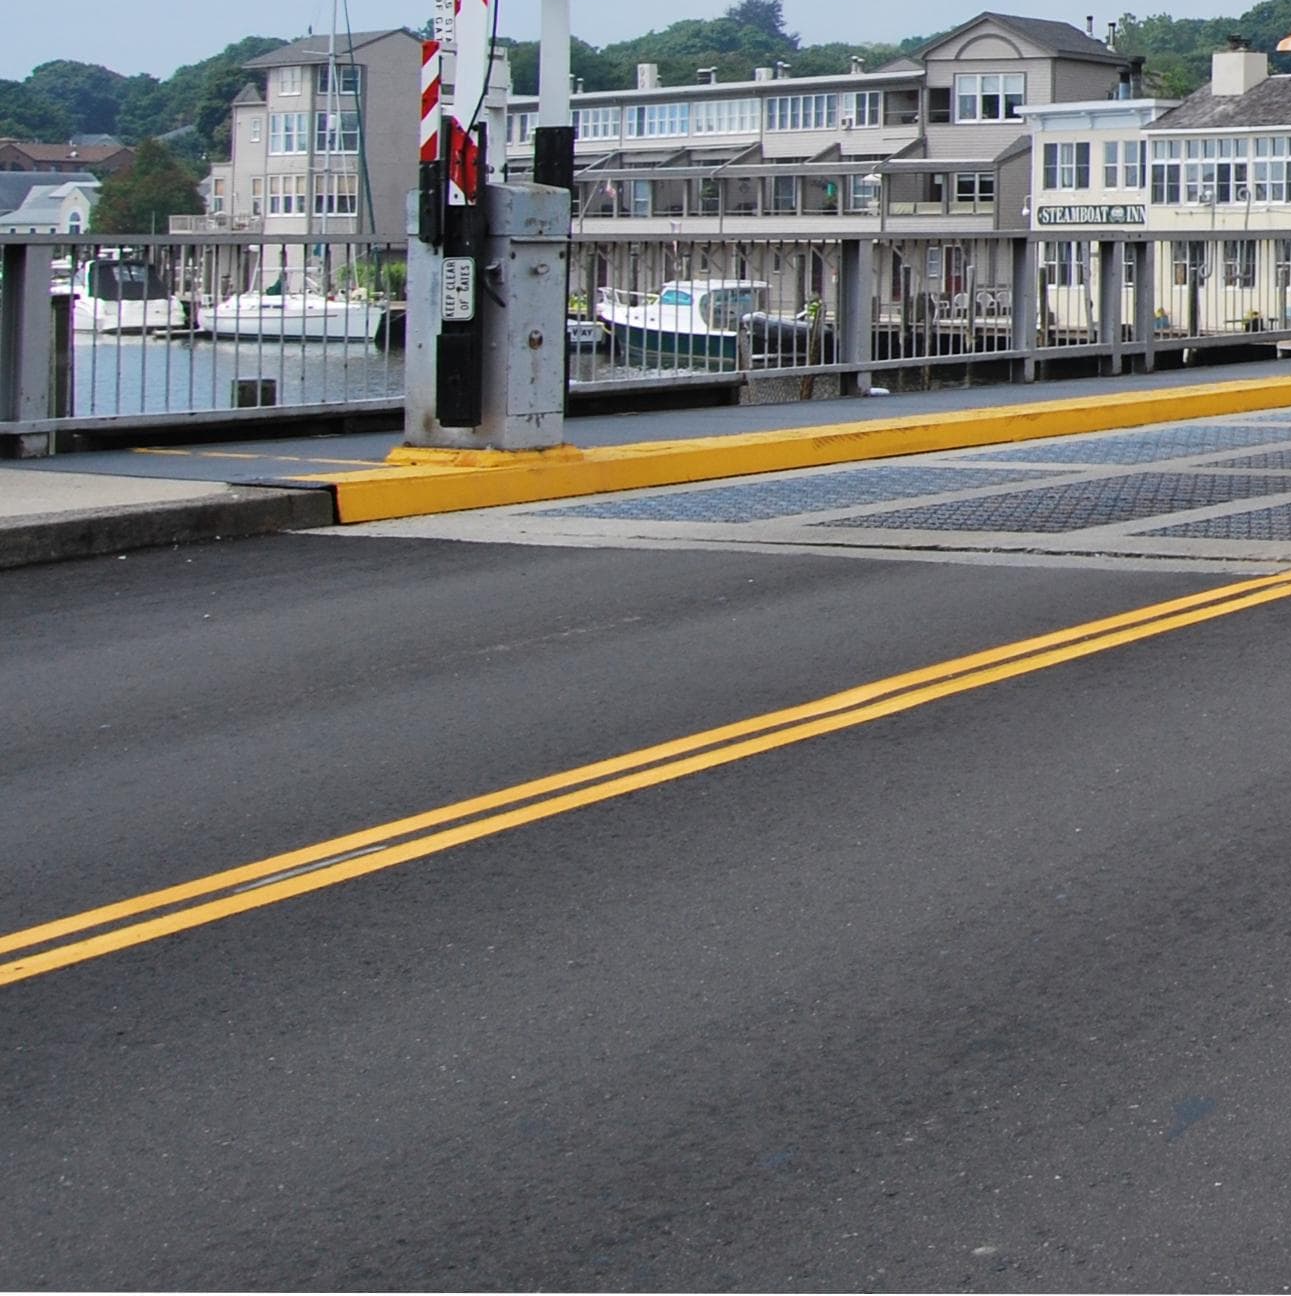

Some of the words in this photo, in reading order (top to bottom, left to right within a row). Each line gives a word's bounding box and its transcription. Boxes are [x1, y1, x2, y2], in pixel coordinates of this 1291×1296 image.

[445, 17, 453, 43] STA
[1042, 206, 1109, 224] STEAMBOAT
[1126, 206, 1146, 223] INN
[446, 261, 456, 291] CLEAR
[460, 265, 470, 292] GATES
[445, 294, 455, 318] KEEP
[459, 299, 470, 311] OF
